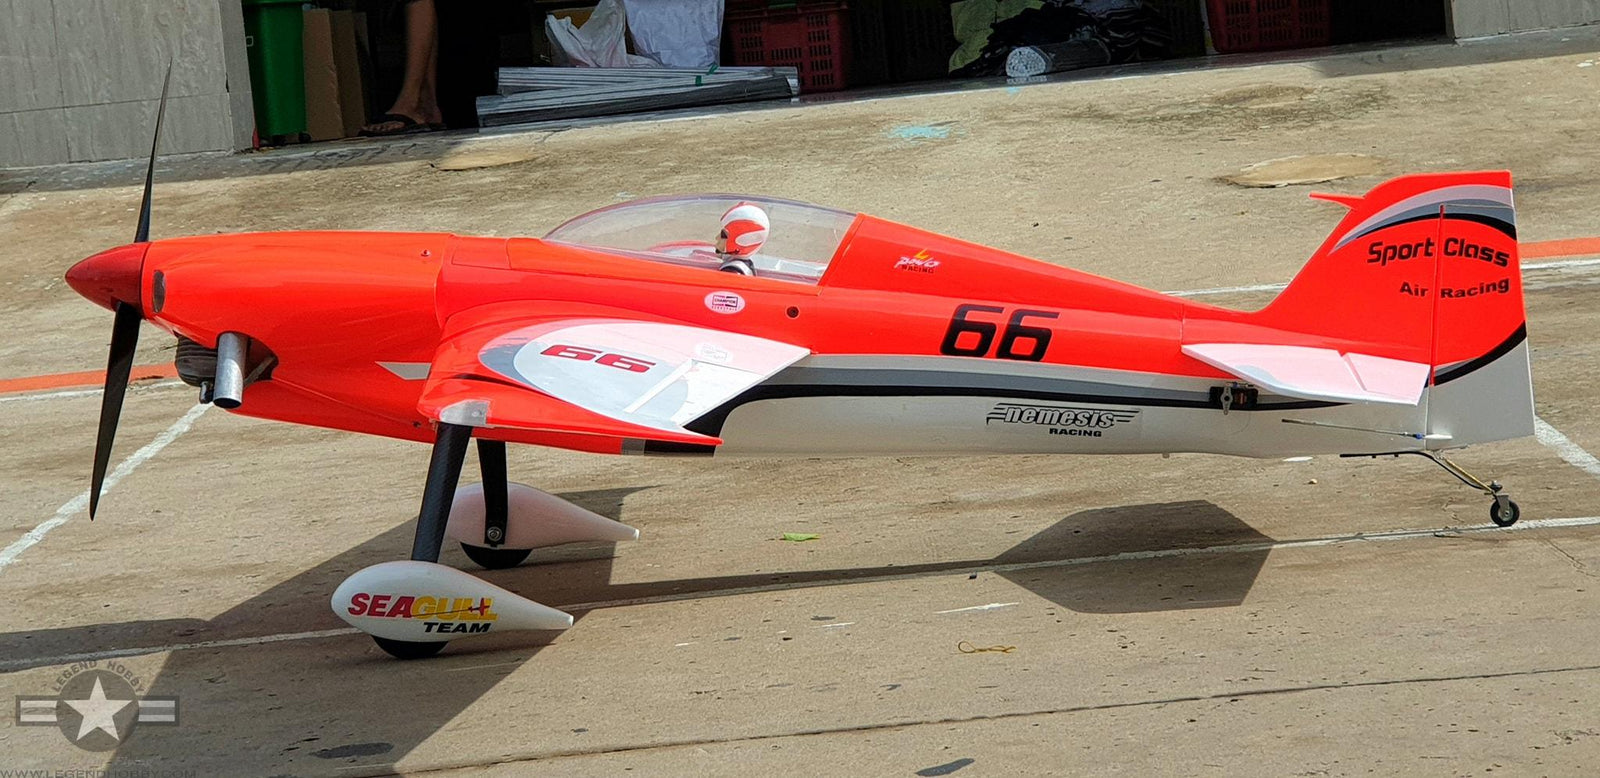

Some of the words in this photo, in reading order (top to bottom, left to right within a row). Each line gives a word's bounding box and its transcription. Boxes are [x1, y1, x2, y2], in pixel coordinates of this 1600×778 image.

[1366, 236, 1435, 267] Sport
[1443, 237, 1510, 268] Class
[1400, 281, 1429, 297] Air
[1440, 278, 1510, 299] Racing
[939, 303, 1060, 362] 66
[540, 344, 657, 373] 66
[1003, 406, 1115, 429] nemesis
[1049, 427, 1102, 437] RACING
[347, 592, 498, 621] SEAGULL
[423, 622, 491, 633] TEAM
